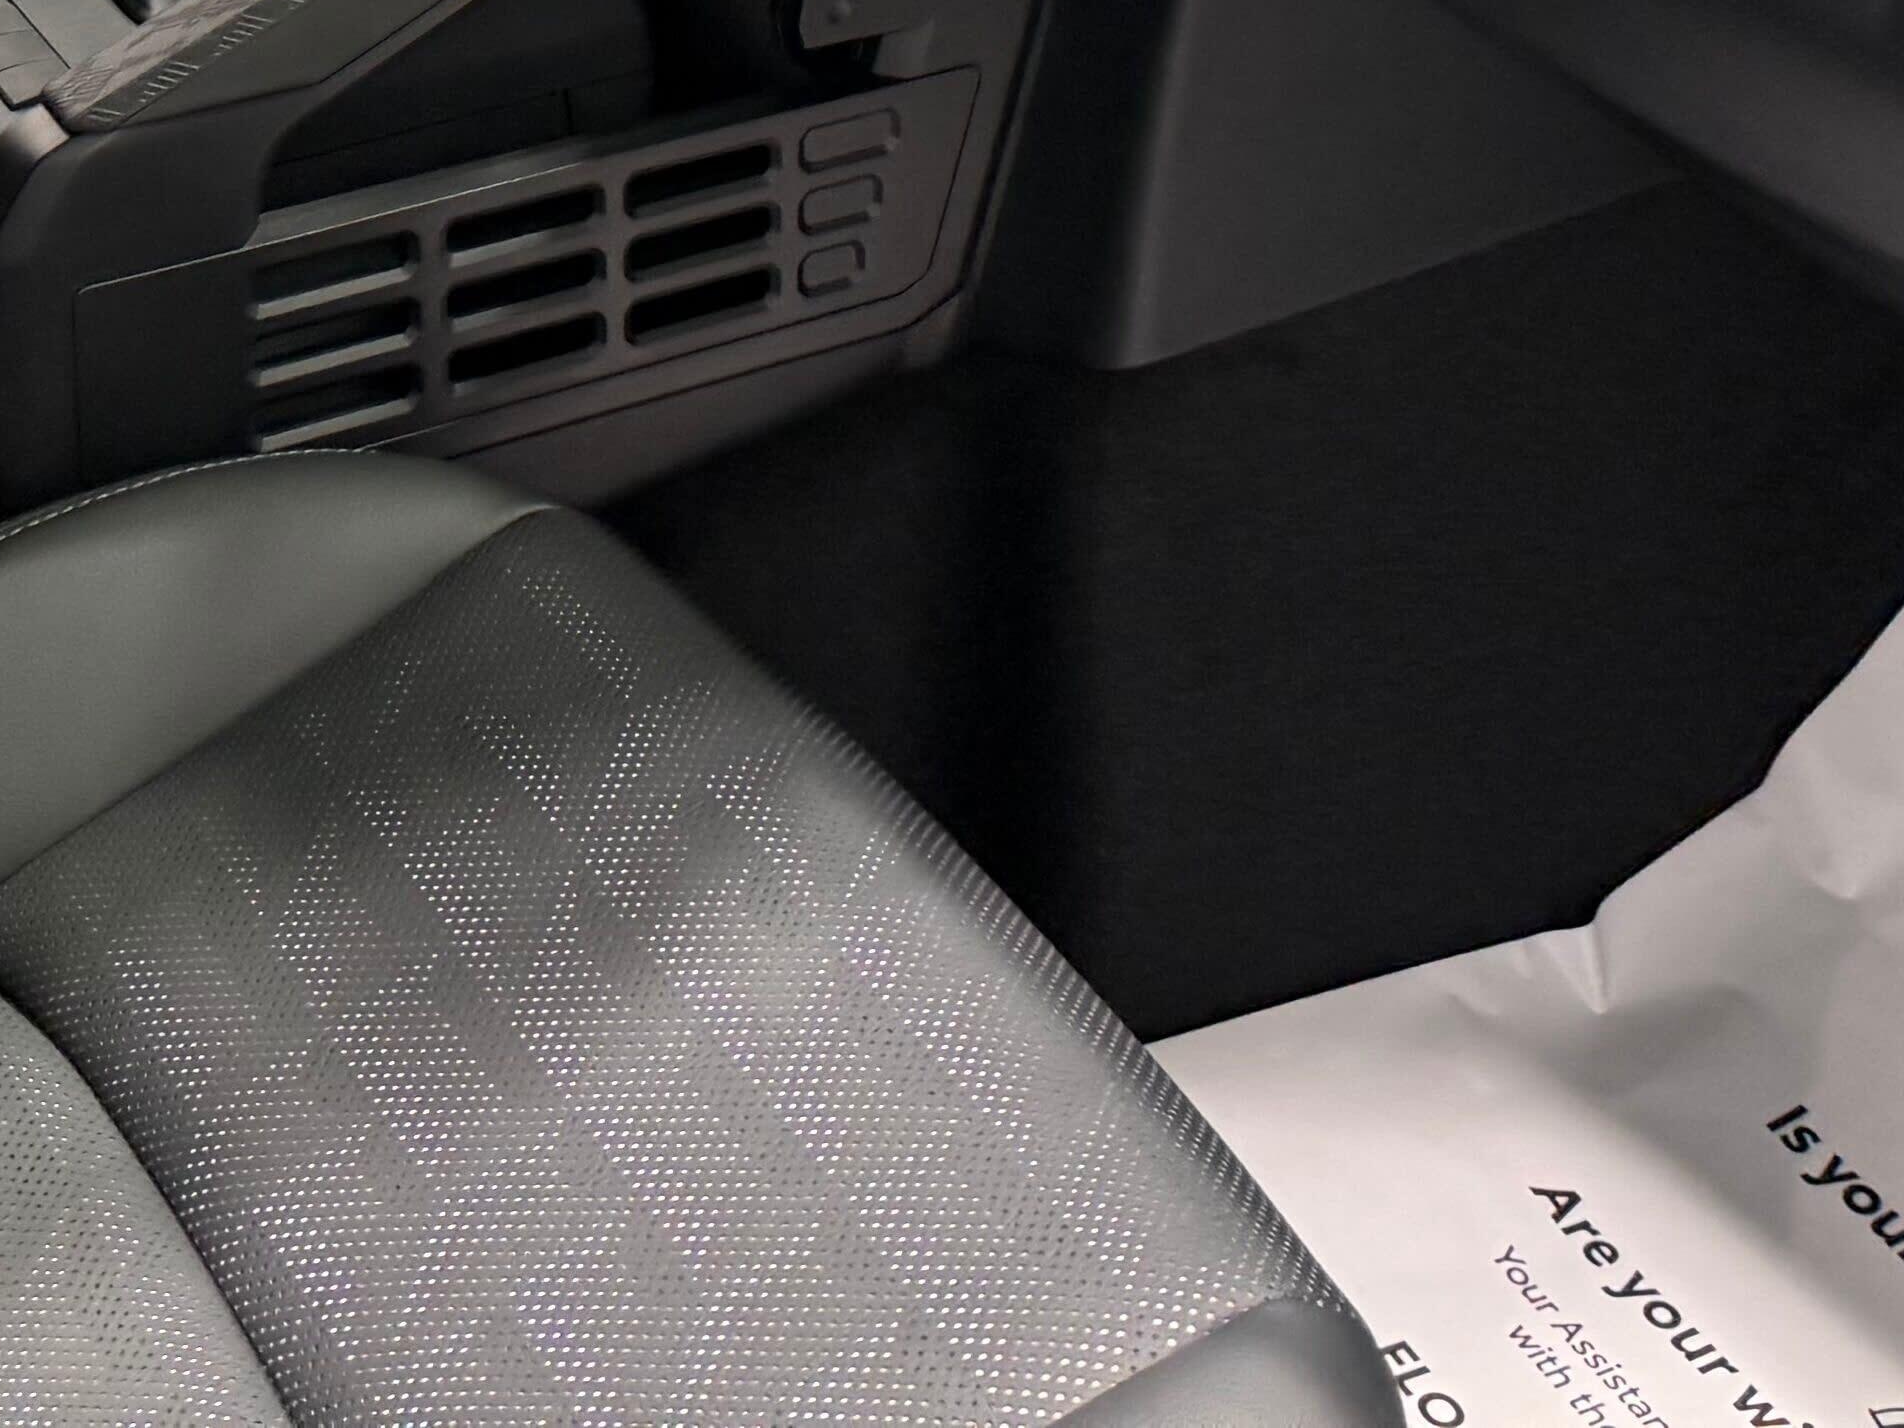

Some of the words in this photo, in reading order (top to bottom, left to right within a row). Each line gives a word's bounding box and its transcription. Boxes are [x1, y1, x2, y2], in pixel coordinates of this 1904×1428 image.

[1766, 1104, 1823, 1154] Is
[1494, 1244, 1560, 1313] Your
[1528, 1185, 1620, 1268] Are
[1600, 1269, 1739, 1375] your
[1508, 1324, 1572, 1389] with
[1570, 1393, 1617, 1428] th
